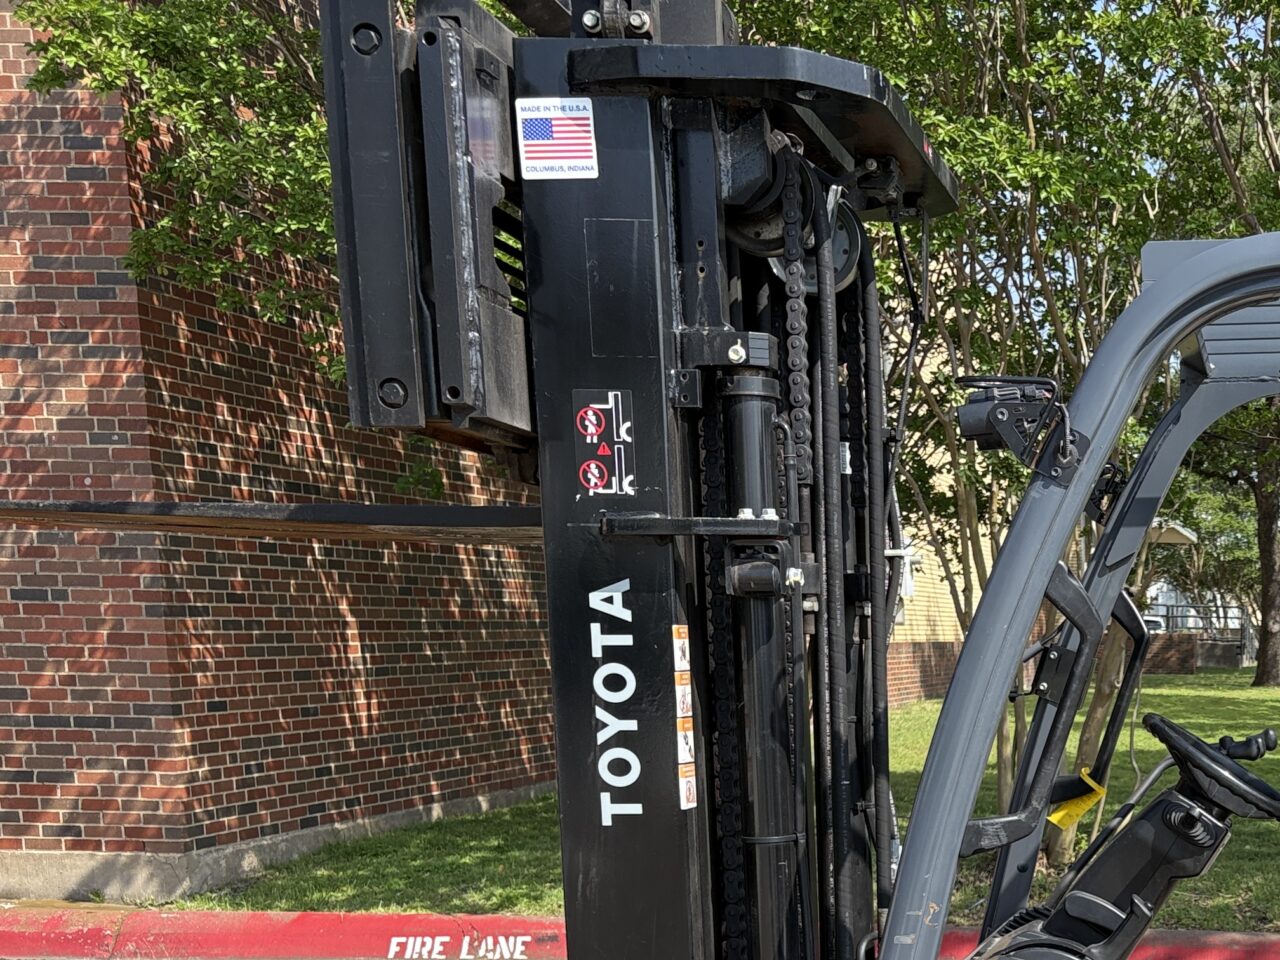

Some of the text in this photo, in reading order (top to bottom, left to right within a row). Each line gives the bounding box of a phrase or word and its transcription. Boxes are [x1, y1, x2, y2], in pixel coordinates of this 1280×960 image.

[520, 105, 542, 113] MADE
[552, 104, 567, 112] THE
[568, 104, 590, 112] U.S.A.
[525, 165, 567, 173] COLUMBUS,
[588, 577, 644, 827] TOYOTA
[387, 935, 532, 960] FIRE LANE
